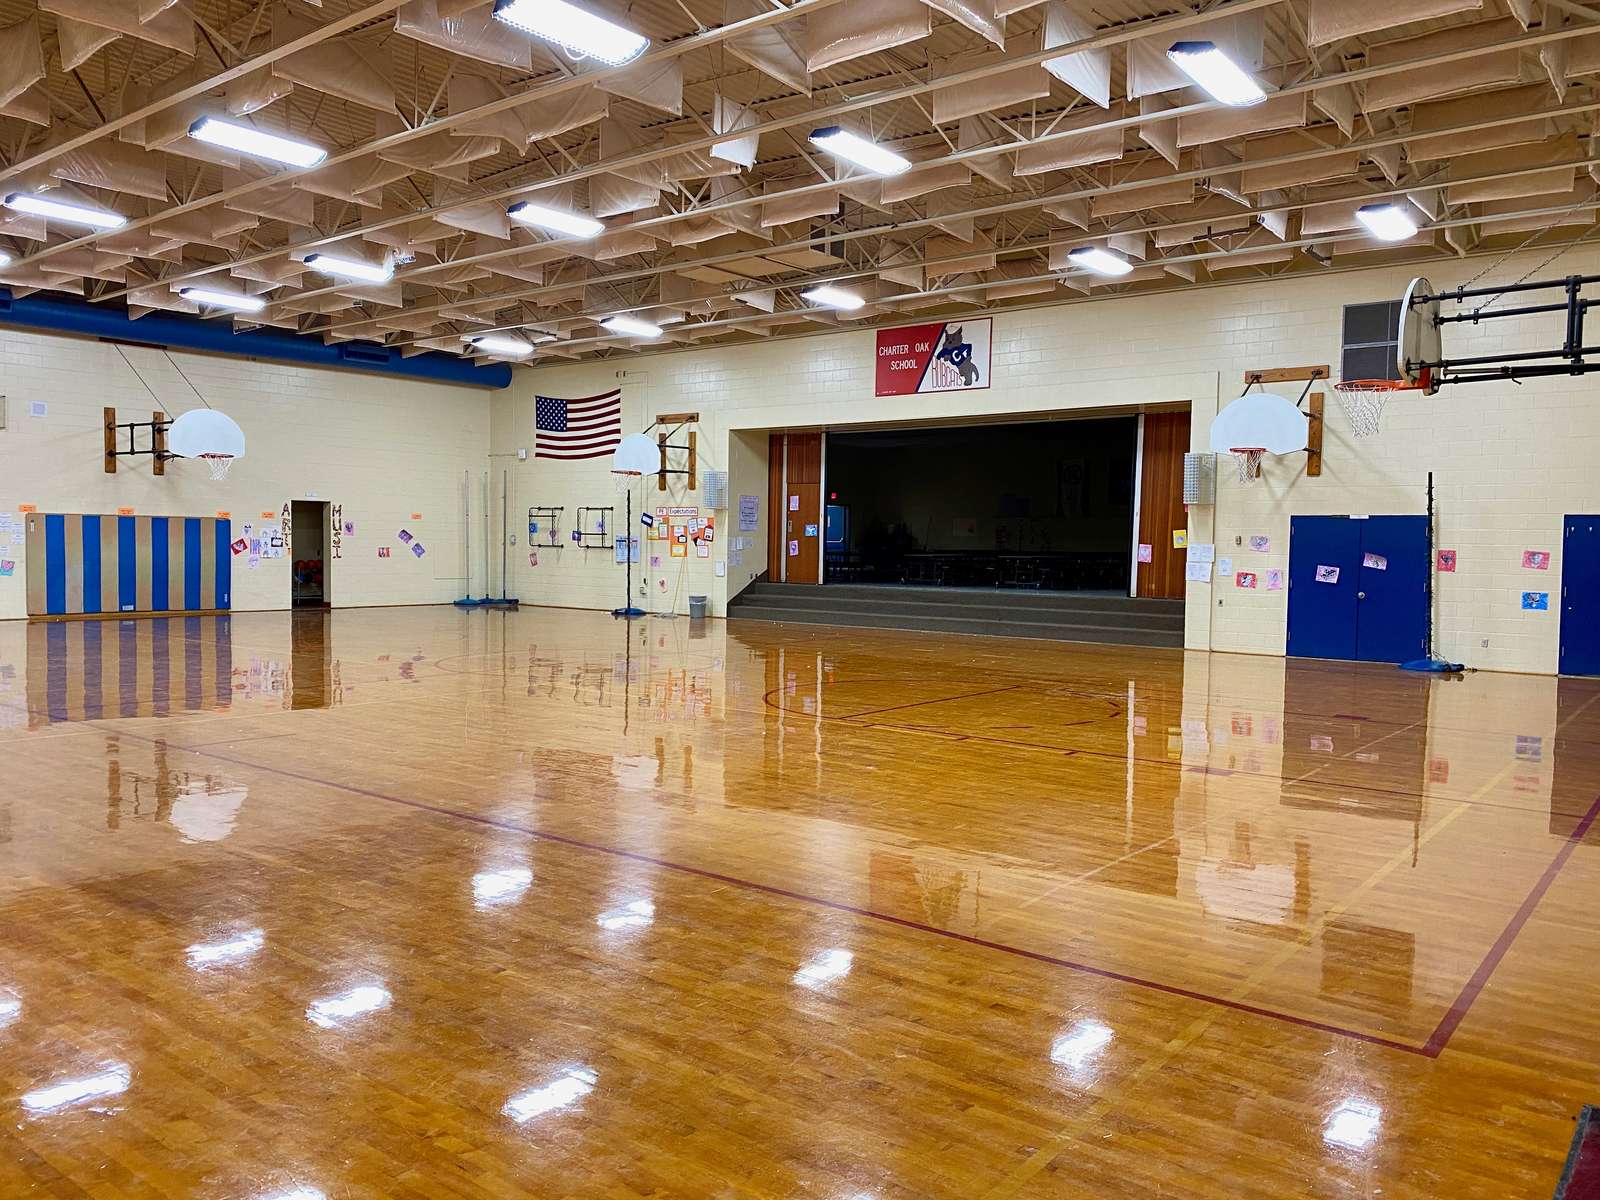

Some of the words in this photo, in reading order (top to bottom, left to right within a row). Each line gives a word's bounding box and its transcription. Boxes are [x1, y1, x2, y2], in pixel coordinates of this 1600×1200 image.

[879, 344, 909, 356] CHARTER
[915, 342, 930, 353] OAK
[890, 359, 918, 370] SCHOOL
